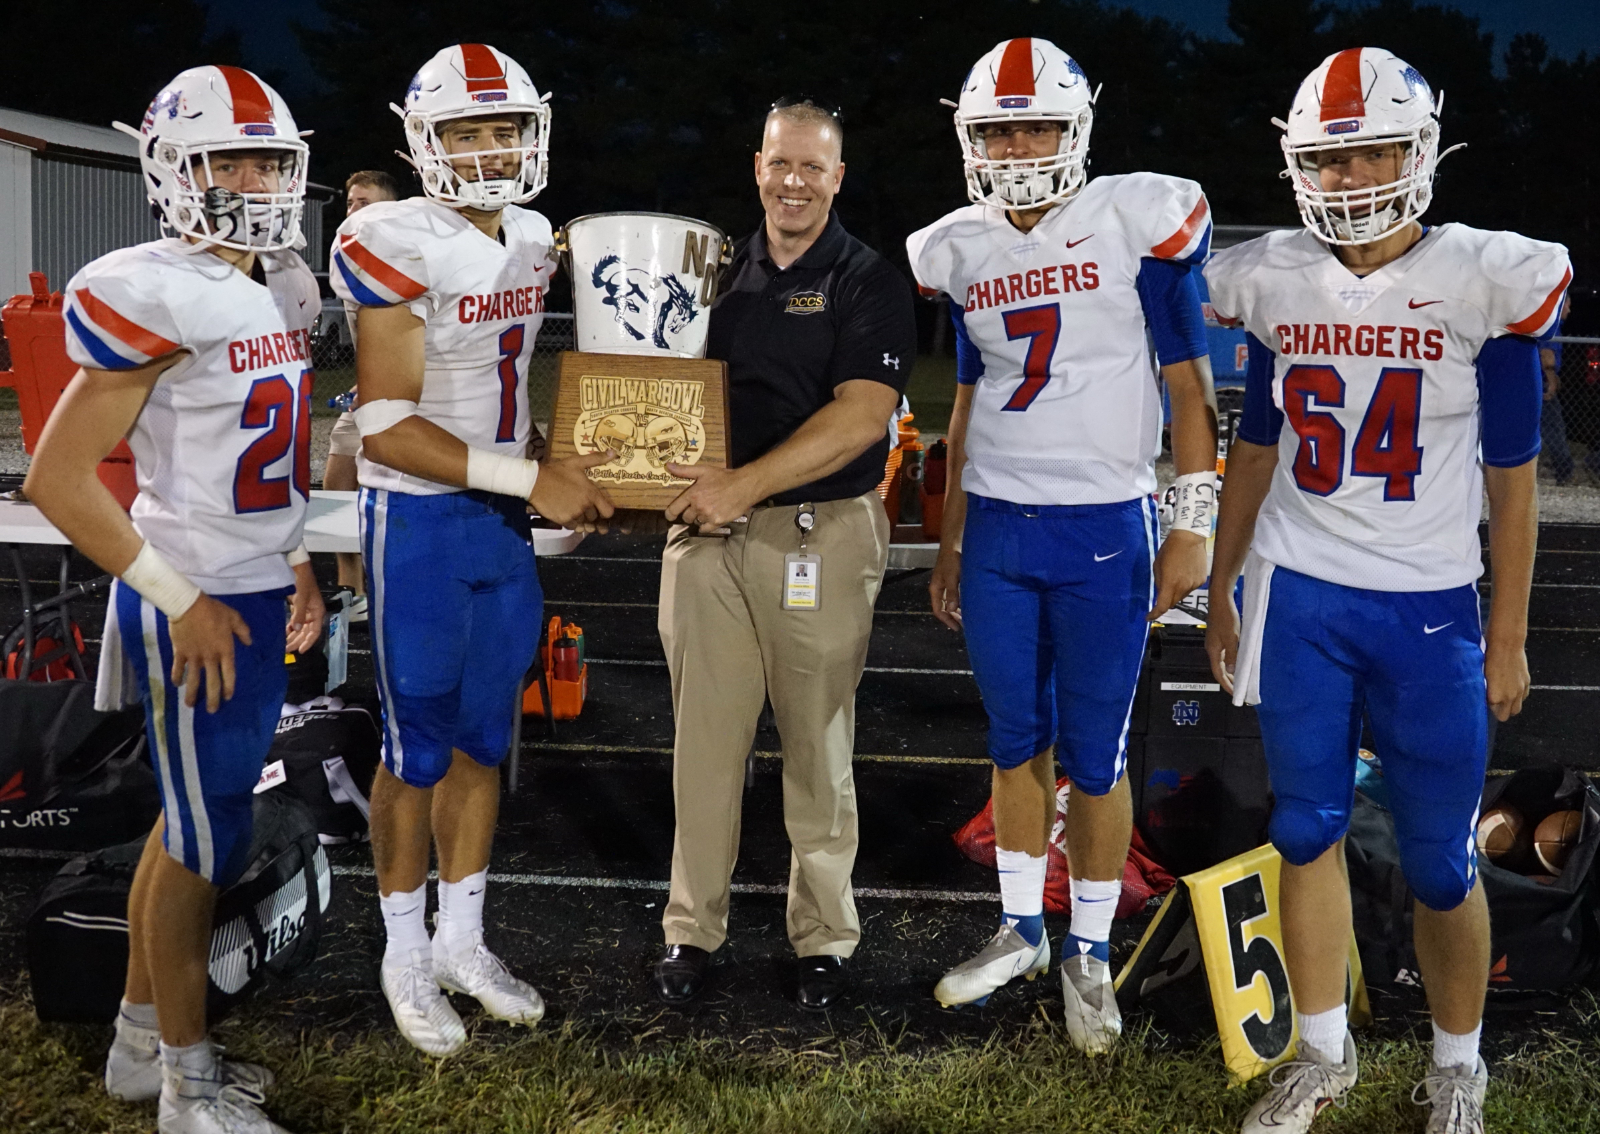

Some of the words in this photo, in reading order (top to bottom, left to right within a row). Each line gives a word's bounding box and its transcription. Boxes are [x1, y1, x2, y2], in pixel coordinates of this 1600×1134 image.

[458, 286, 545, 324] CHARGER
[789, 296, 823, 307] DCCS
[964, 261, 1100, 312] CHARGERS
[228, 327, 312, 373] CHARGER
[1000, 302, 1061, 412] 7
[1276, 323, 1444, 361] CHARGERS
[495, 323, 525, 443] 1
[581, 378, 625, 411] CIVIL
[626, 380, 659, 405] WAR
[660, 380, 703, 417] BOWL
[1282, 363, 1424, 502] 64
[1222, 873, 1294, 1060] 5
